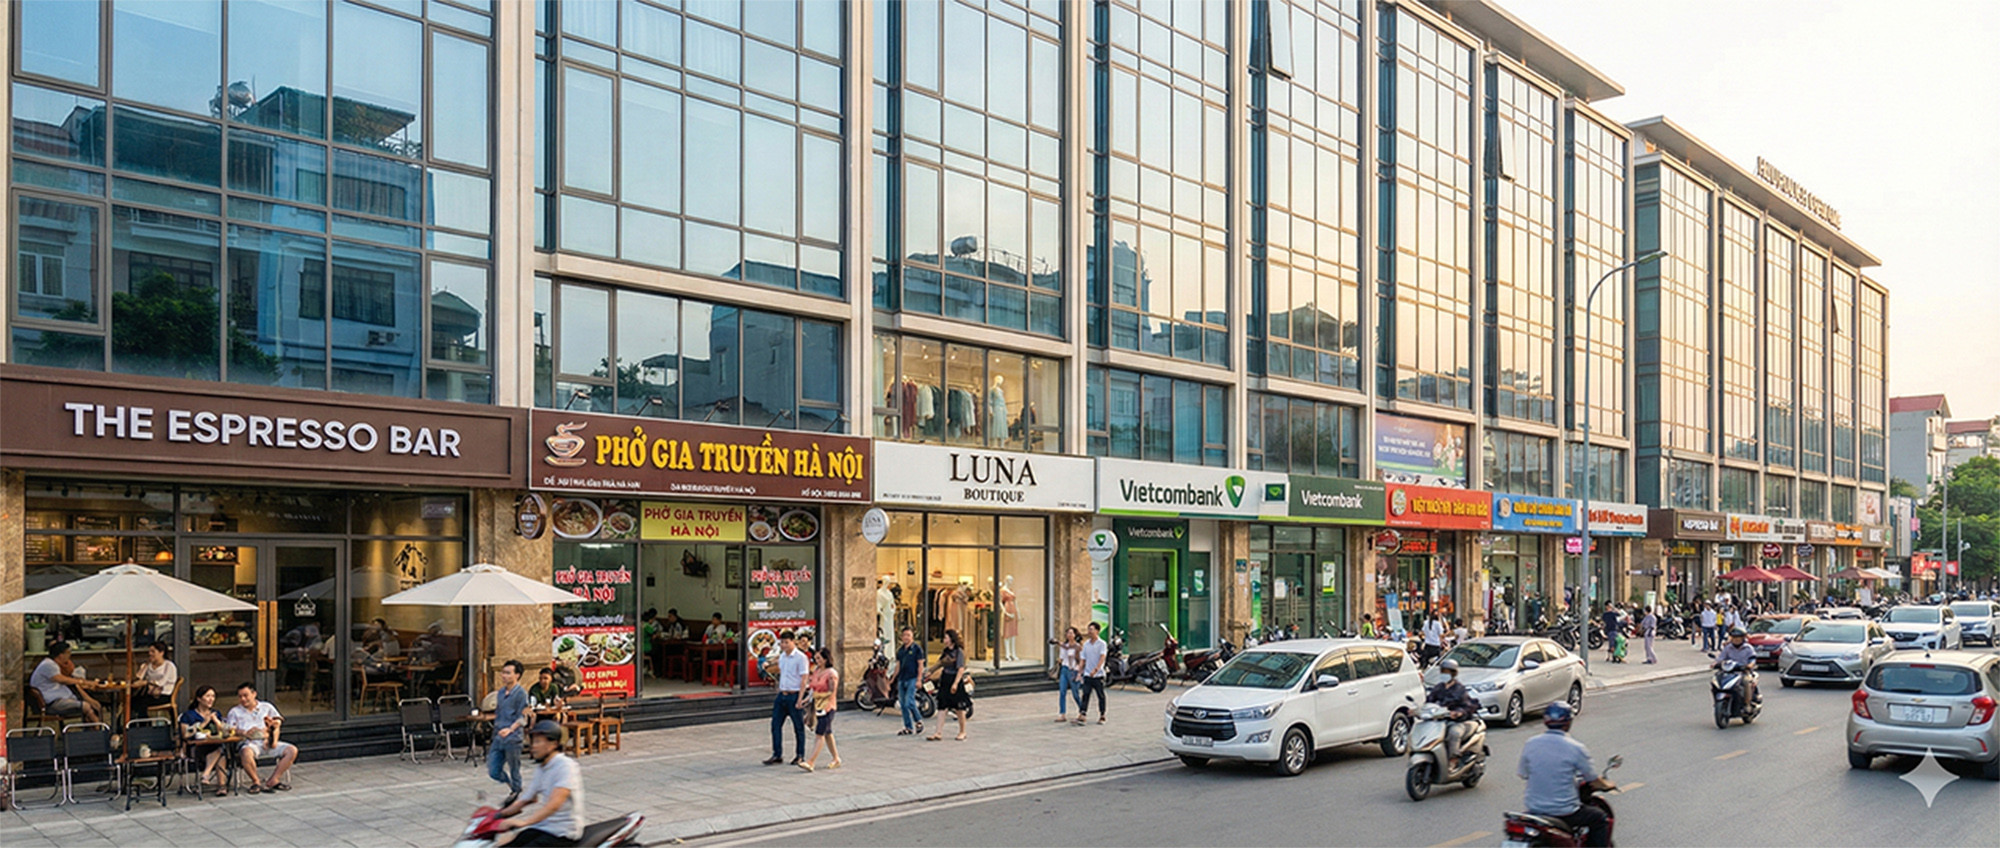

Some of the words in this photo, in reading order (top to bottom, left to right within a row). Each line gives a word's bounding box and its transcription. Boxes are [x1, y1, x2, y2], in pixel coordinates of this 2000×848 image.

[64, 402, 153, 440] THE
[167, 409, 378, 453] ESPRESSO
[389, 425, 461, 458] BAR
[595, 425, 648, 468] PHỞ
[652, 439, 694, 471] GIA
[699, 432, 789, 476] TRUYỀN
[793, 442, 824, 478] HÀ
[827, 445, 864, 485] NỘI
[950, 453, 1037, 487] LUNA
[964, 488, 1025, 504] BOUTIQUE
[1120, 479, 1223, 507] Vietcombank
[1301, 489, 1364, 509] Vietcombank
[674, 508, 695, 521] GIA
[670, 522, 691, 536] HÀ
[695, 523, 719, 539] NỘI
[1127, 526, 1175, 539] Vietcombank
